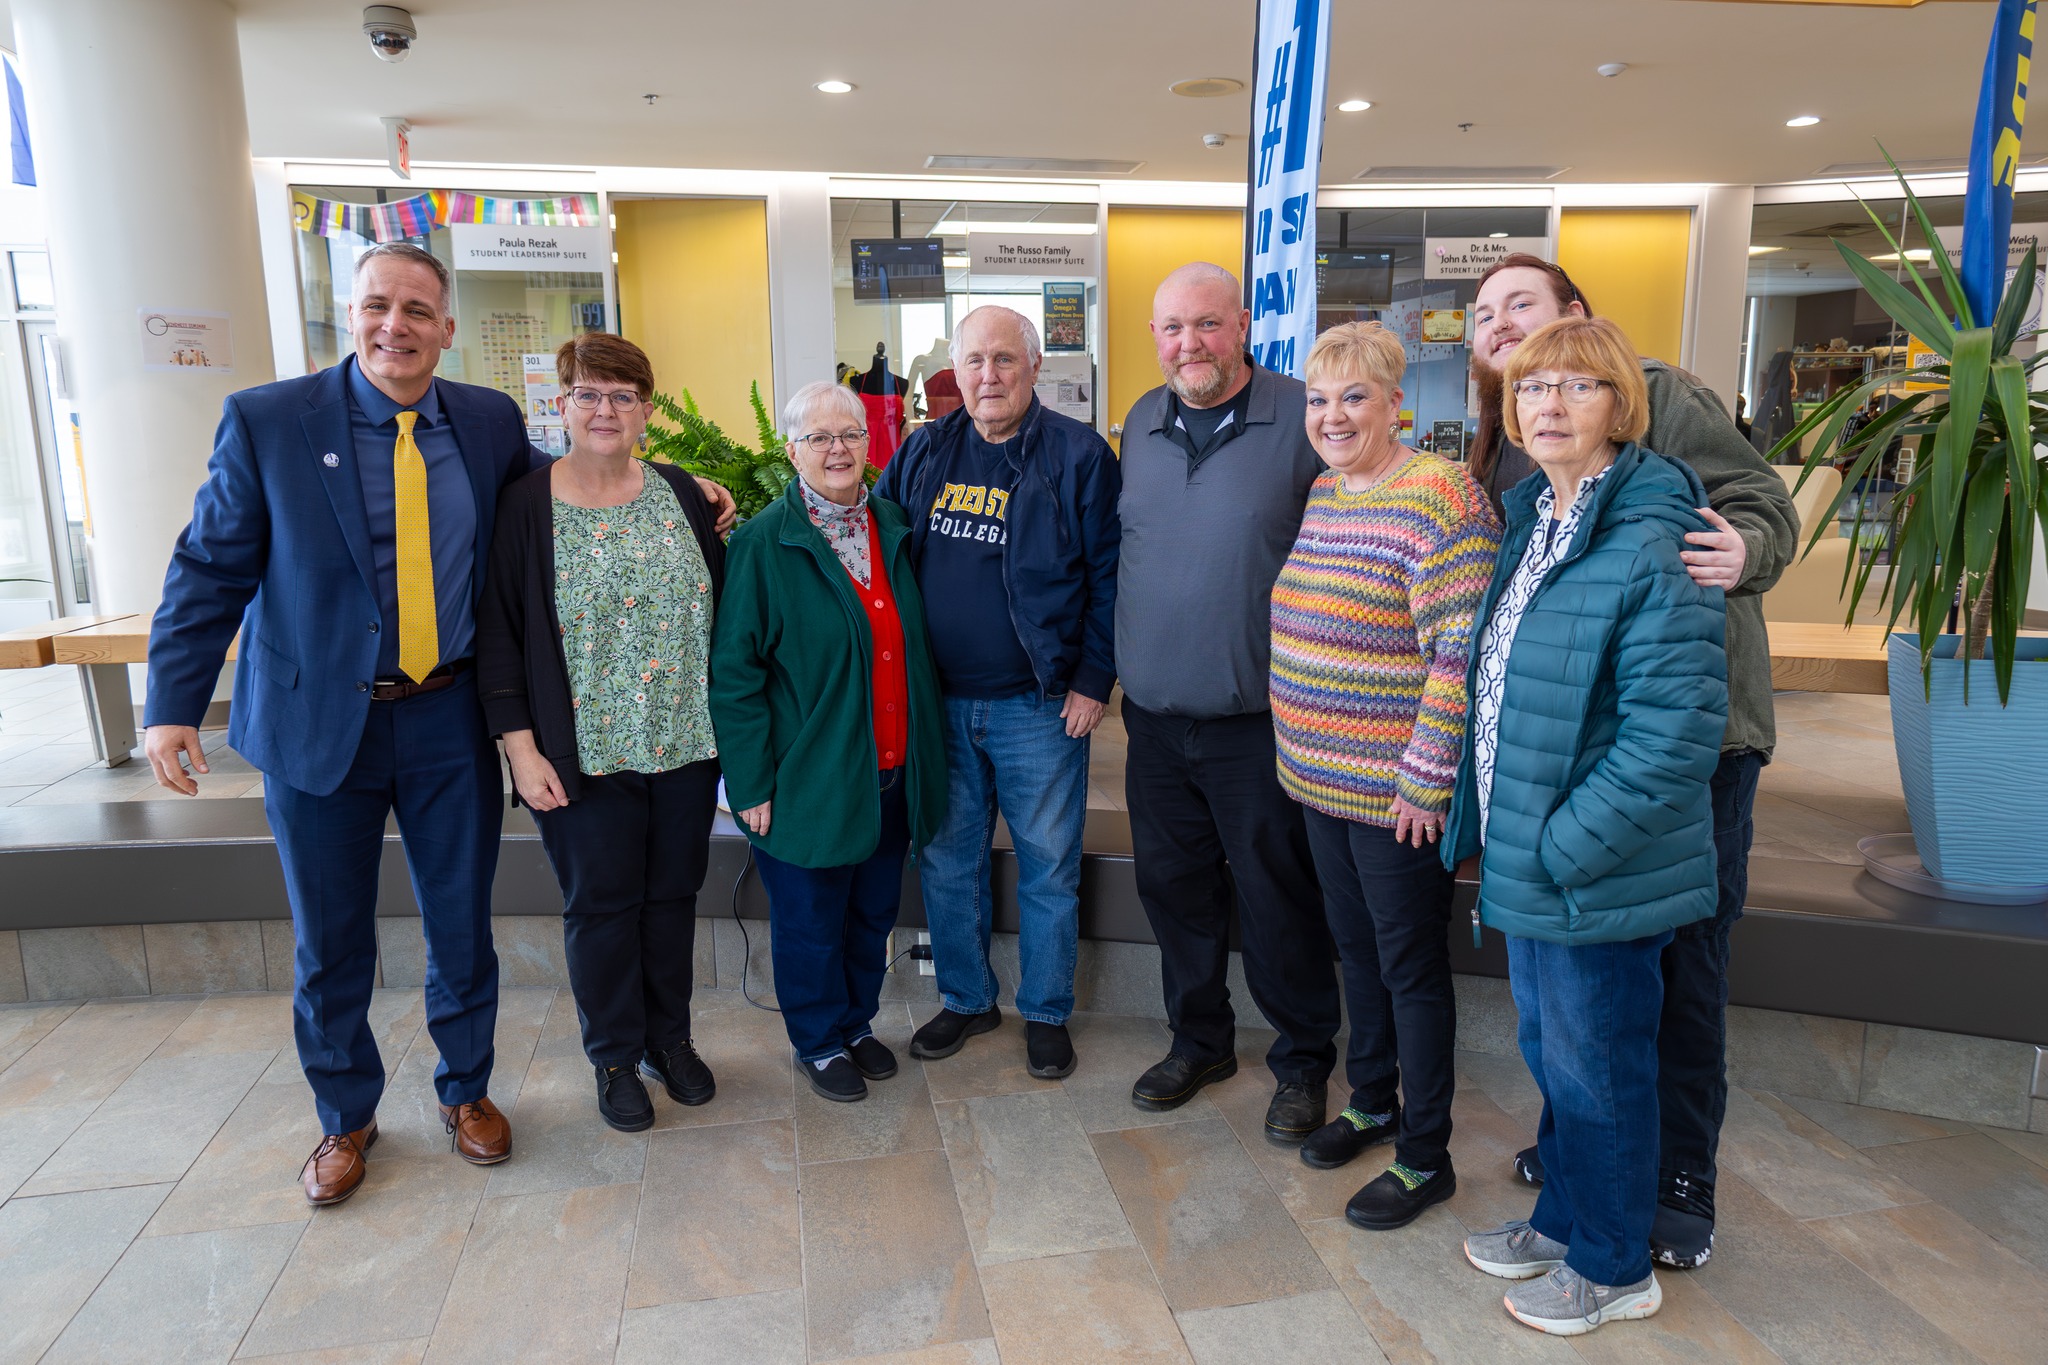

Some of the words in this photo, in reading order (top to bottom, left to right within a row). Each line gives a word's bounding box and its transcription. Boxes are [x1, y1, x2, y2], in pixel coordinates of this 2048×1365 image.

[499, 238, 526, 248] Paula
[528, 238, 558, 248] Rezak
[998, 245, 1015, 254] The
[1017, 245, 1042, 255] Russo
[1044, 246, 1071, 257] Family
[1470, 244, 1481, 252] Dr.
[1483, 244, 1489, 252] &
[1491, 244, 1508, 252] Mrs.
[470, 249, 508, 257] STUDENT
[511, 250, 561, 258] LEADERSHIP
[563, 251, 587, 259] SUITE
[1440, 255, 1460, 264] John
[1461, 255, 1468, 263] &
[1470, 255, 1495, 263] Vivien
[525, 357, 540, 365] 301
